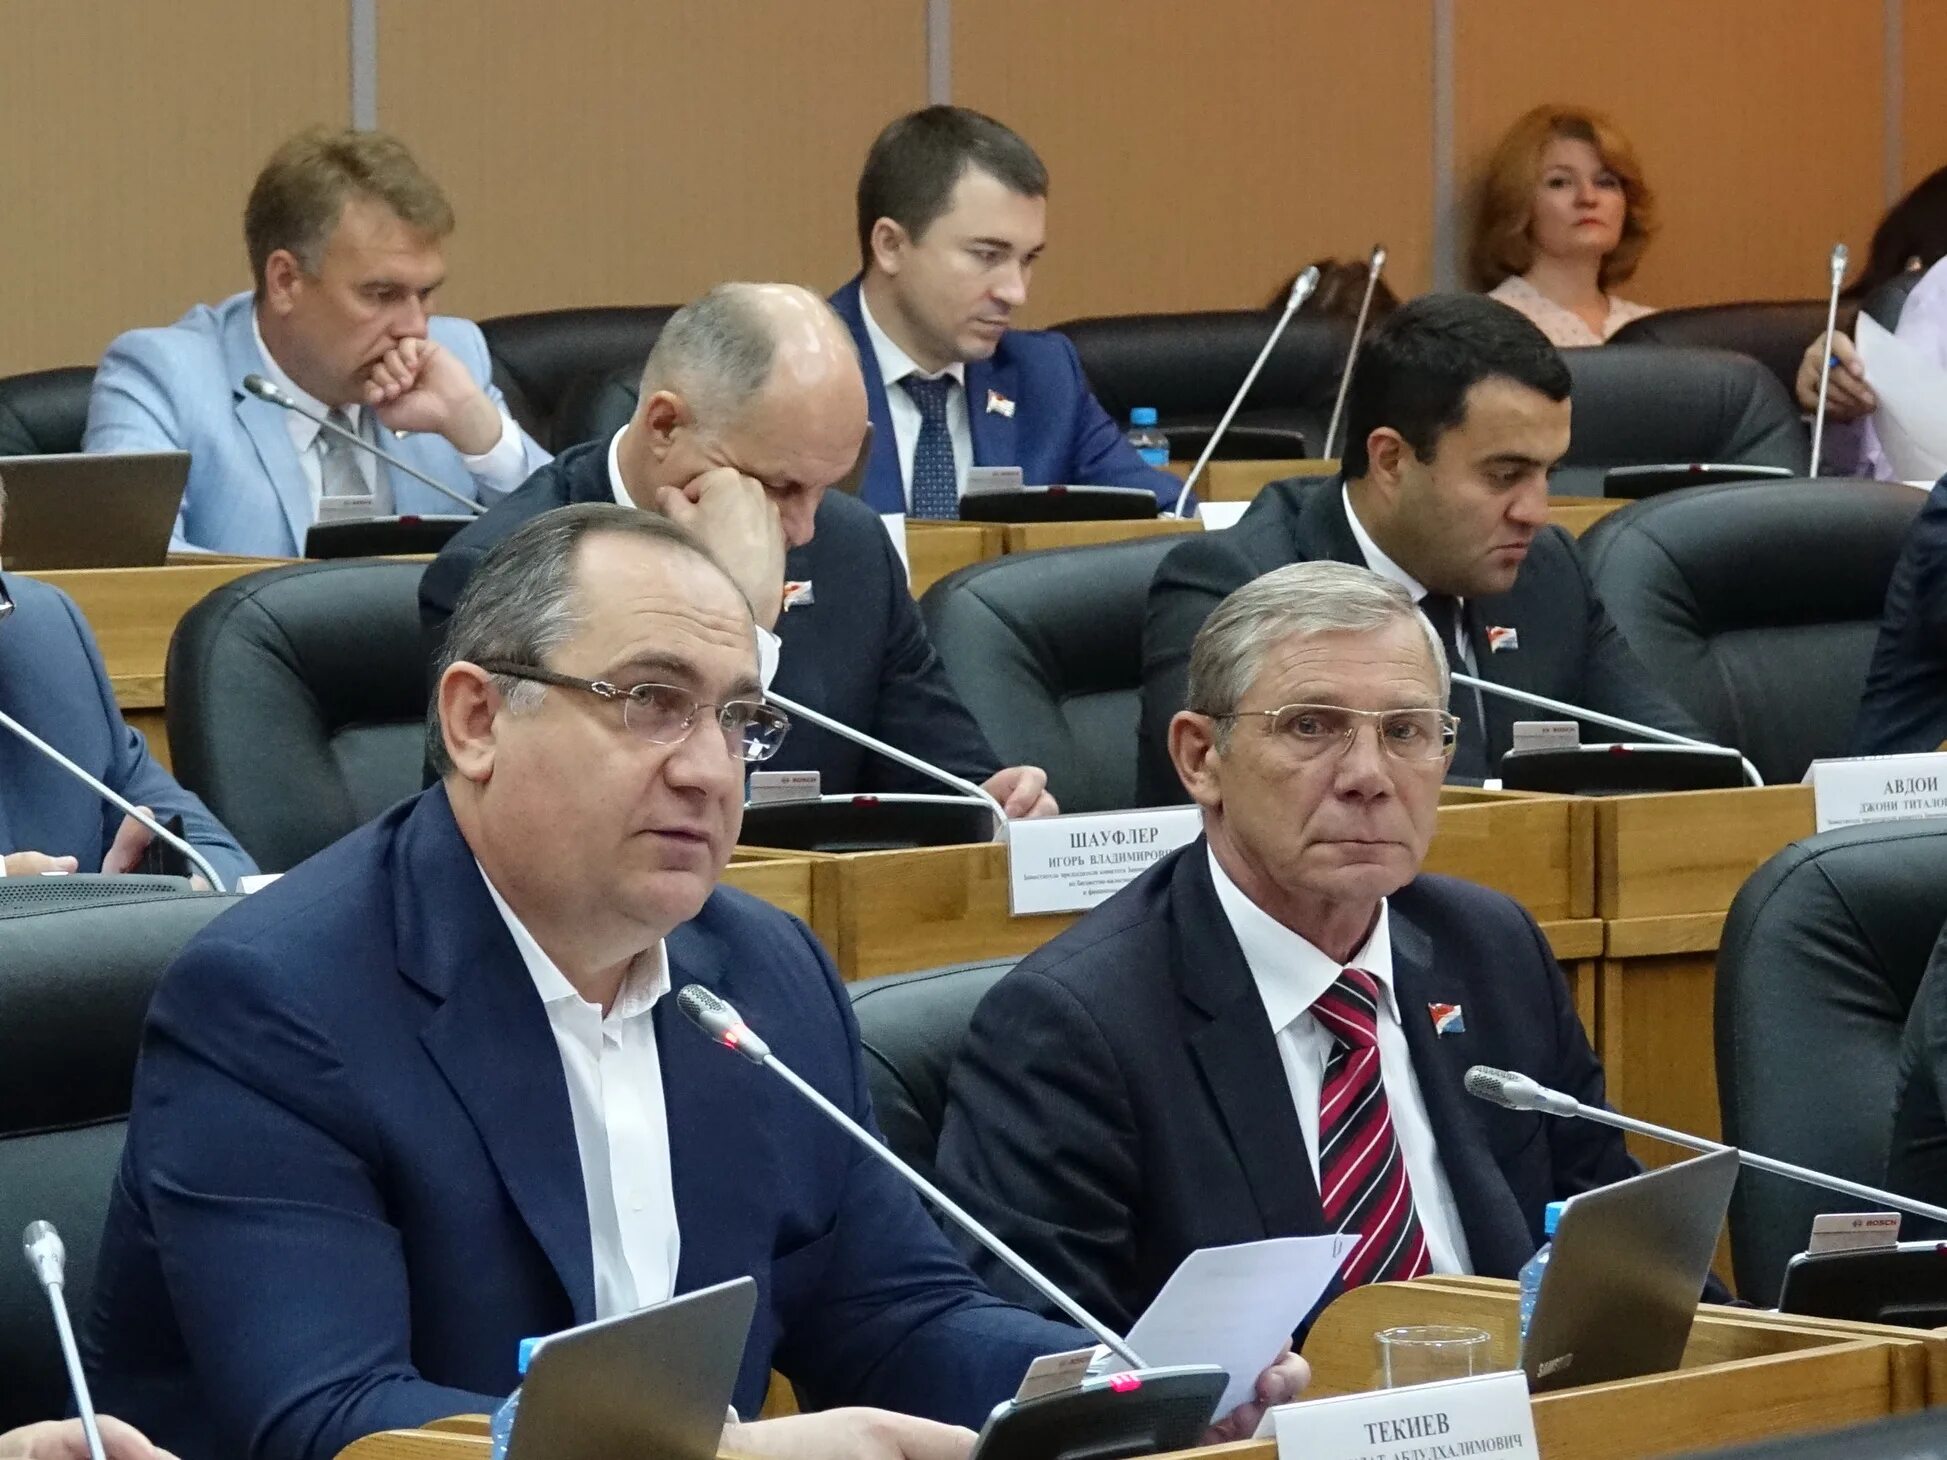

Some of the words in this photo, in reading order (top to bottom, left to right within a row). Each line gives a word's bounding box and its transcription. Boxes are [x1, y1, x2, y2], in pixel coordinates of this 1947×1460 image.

[1884, 777, 1938, 796] АВДОИ
[1860, 800, 1899, 814] ДЖОНИ
[1069, 827, 1160, 849] ШАУФЛЕР
[1049, 855, 1086, 868] ИГОРЬ
[1364, 1412, 1450, 1445] ТЕКИЕВ
